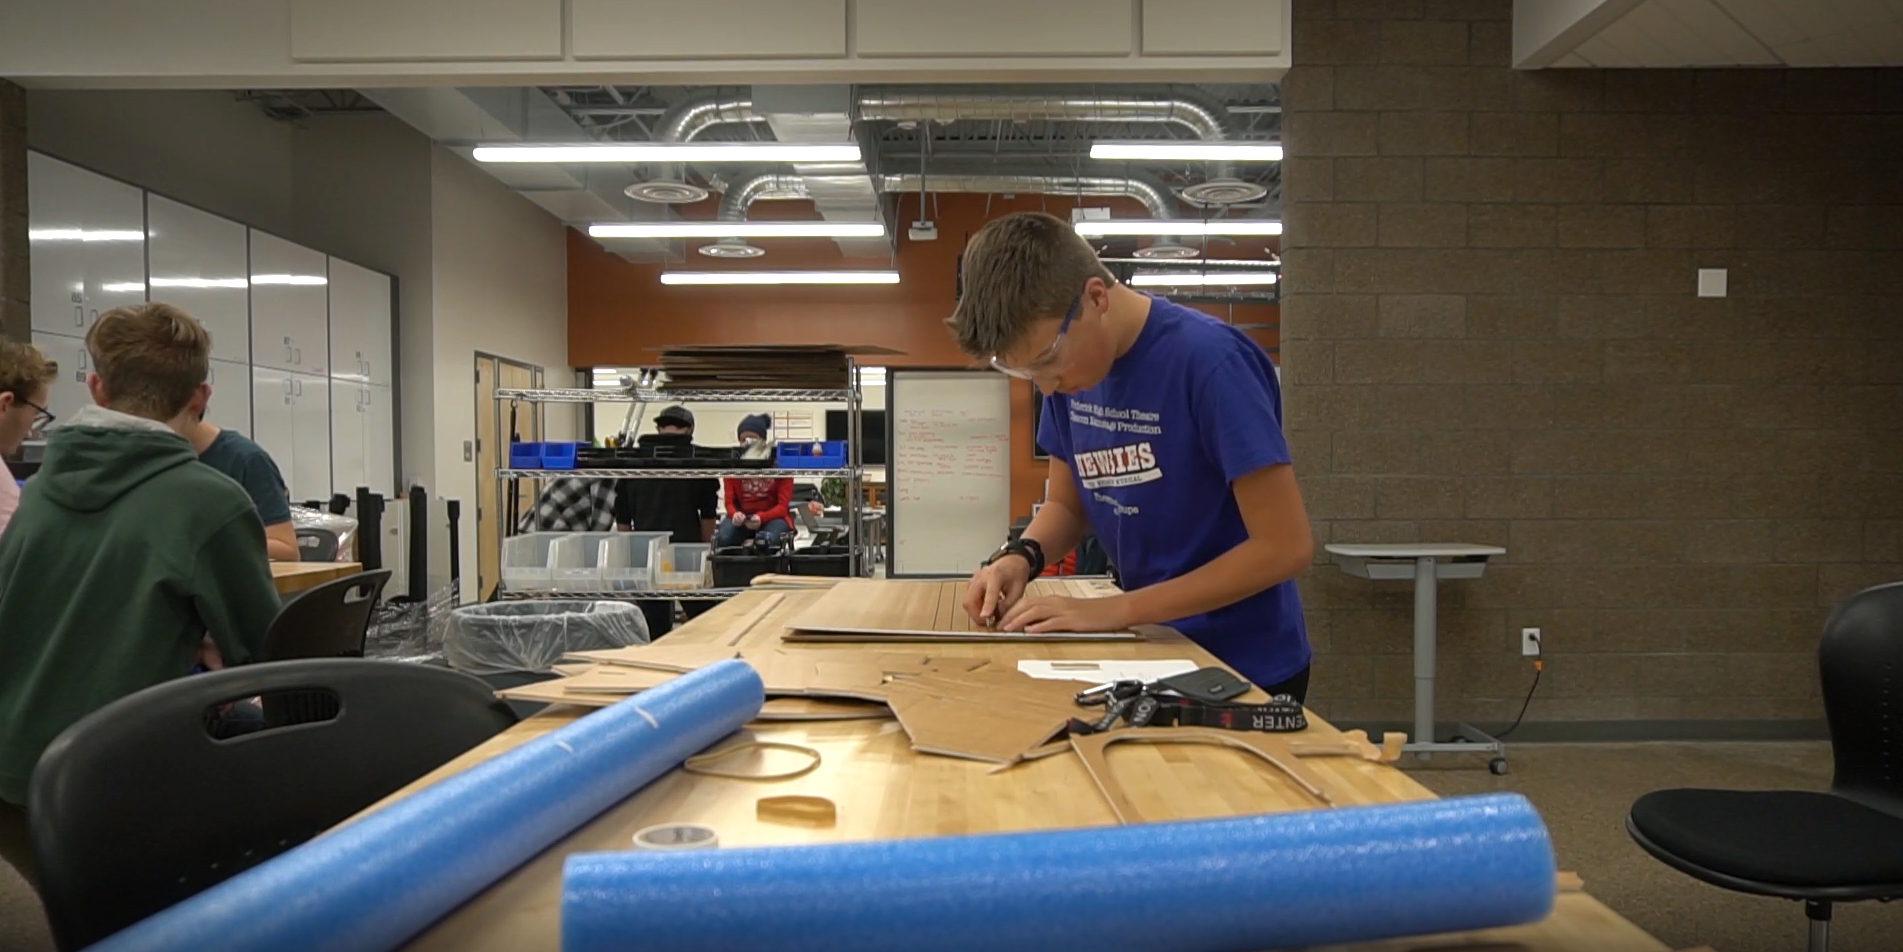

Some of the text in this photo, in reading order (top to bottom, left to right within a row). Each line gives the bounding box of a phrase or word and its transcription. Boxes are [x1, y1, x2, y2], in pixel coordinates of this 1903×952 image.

[1105, 407, 1130, 419] School
[1118, 421, 1162, 435] Production
[1252, 714, 1306, 730] ENTER
